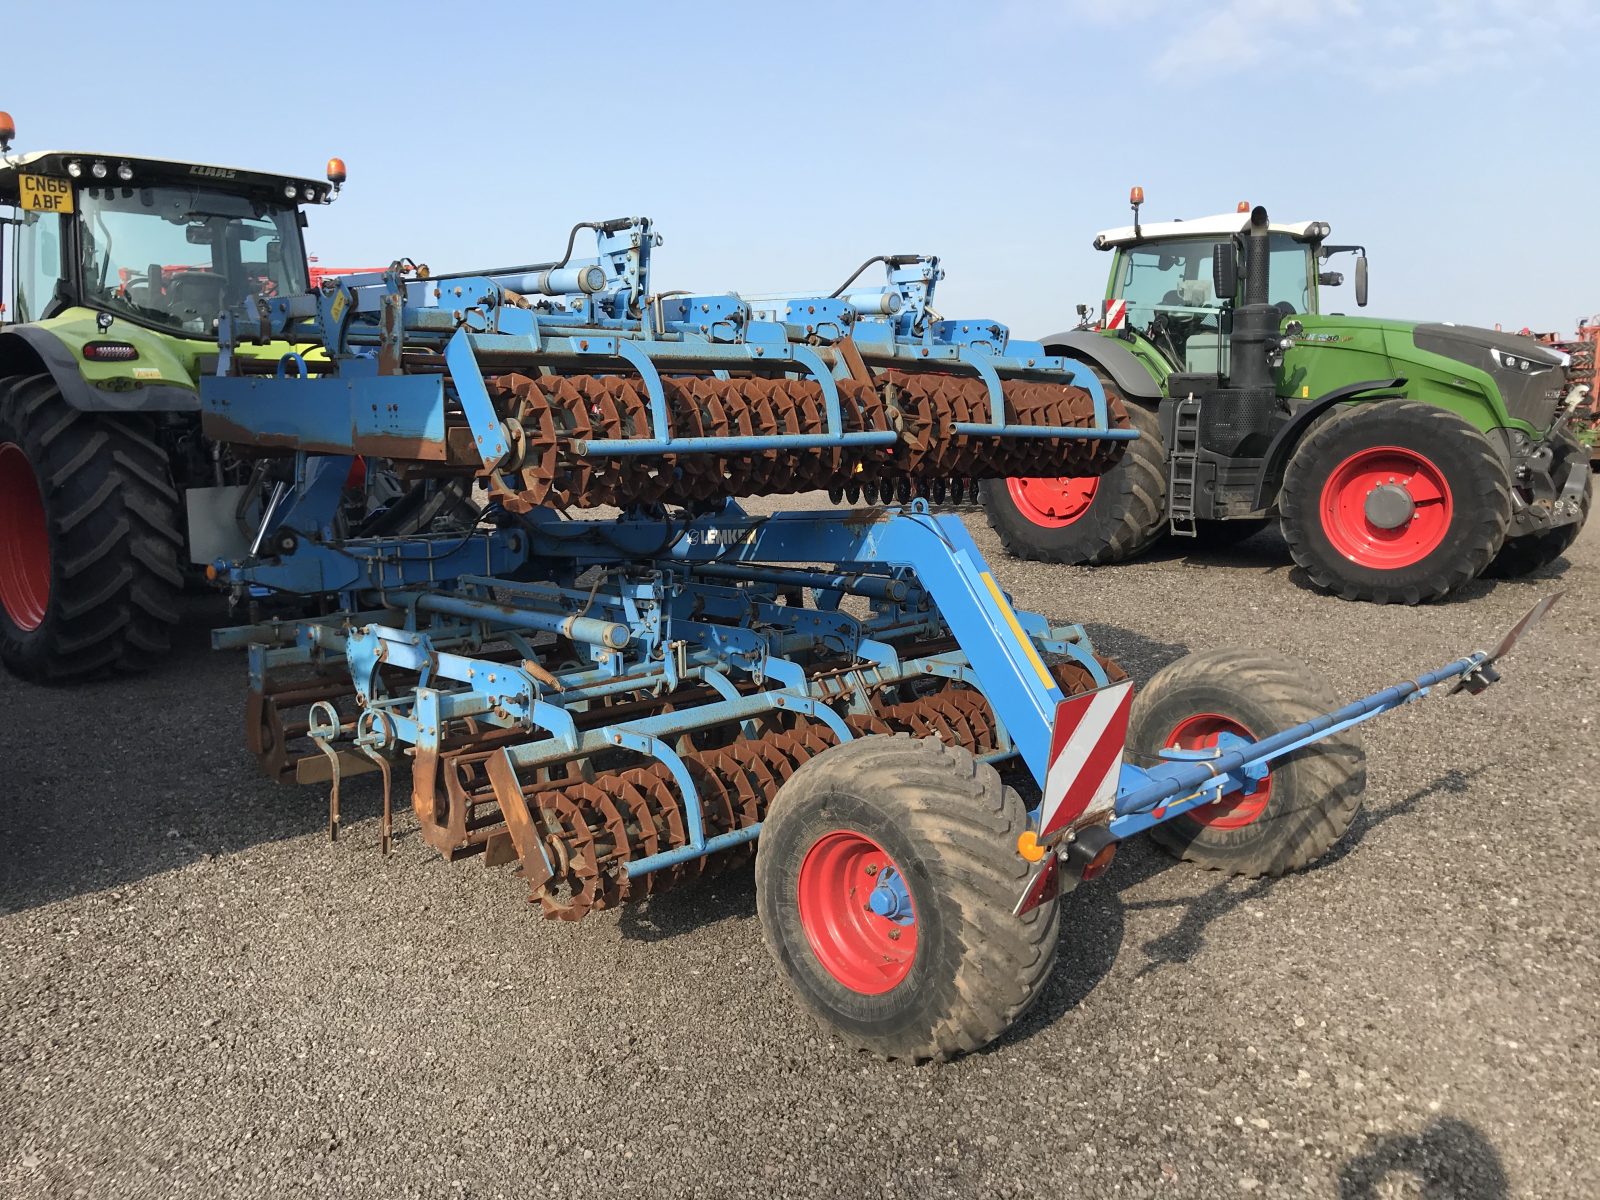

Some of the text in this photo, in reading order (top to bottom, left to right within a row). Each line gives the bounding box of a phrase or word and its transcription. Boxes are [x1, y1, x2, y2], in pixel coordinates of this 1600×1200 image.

[189, 165, 236, 178] CLAAS
[25, 176, 68, 193] CN66
[32, 193, 63, 209] ABF
